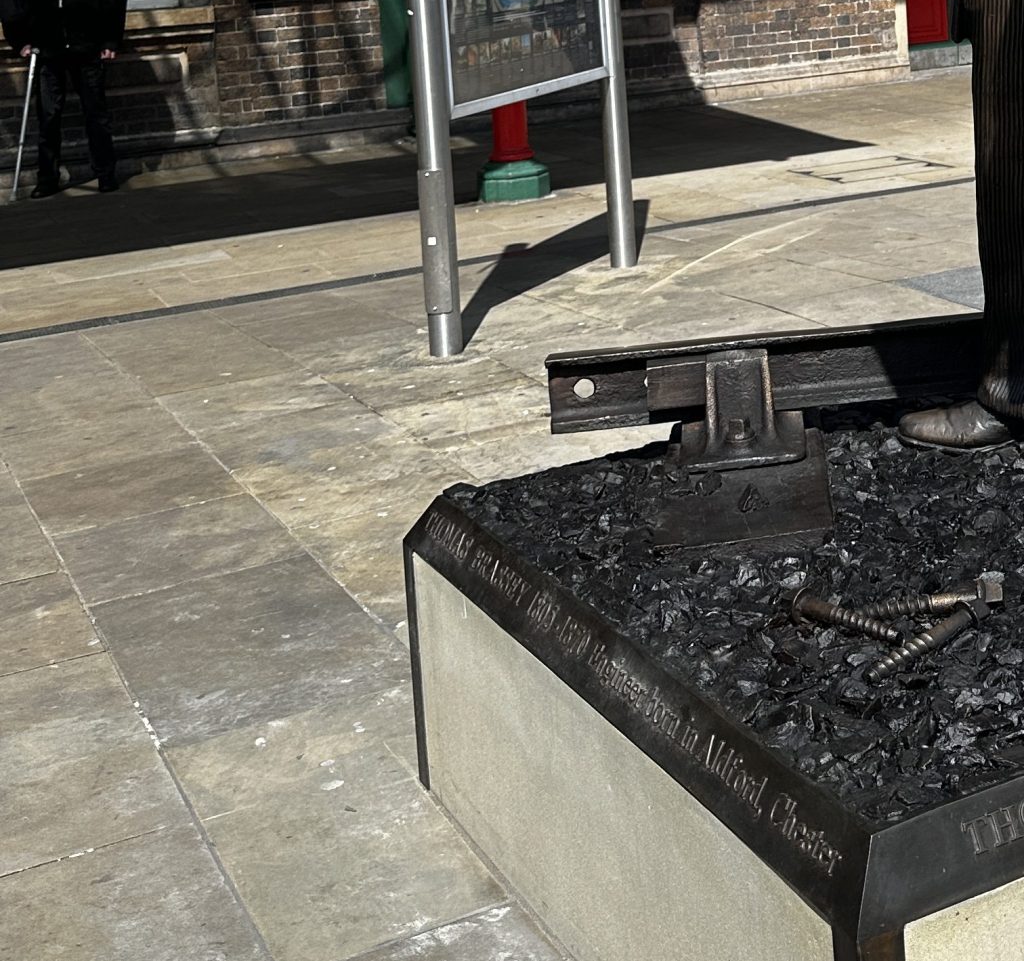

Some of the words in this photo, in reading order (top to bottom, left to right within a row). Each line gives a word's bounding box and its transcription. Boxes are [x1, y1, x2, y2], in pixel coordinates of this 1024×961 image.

[424, 511, 476, 560] THOMAS
[471, 546, 532, 606] BRASSEY
[587, 643, 649, 707] Engineer
[645, 687, 681, 739] born
[681, 716, 698, 753] in
[769, 792, 843, 878] Chester
